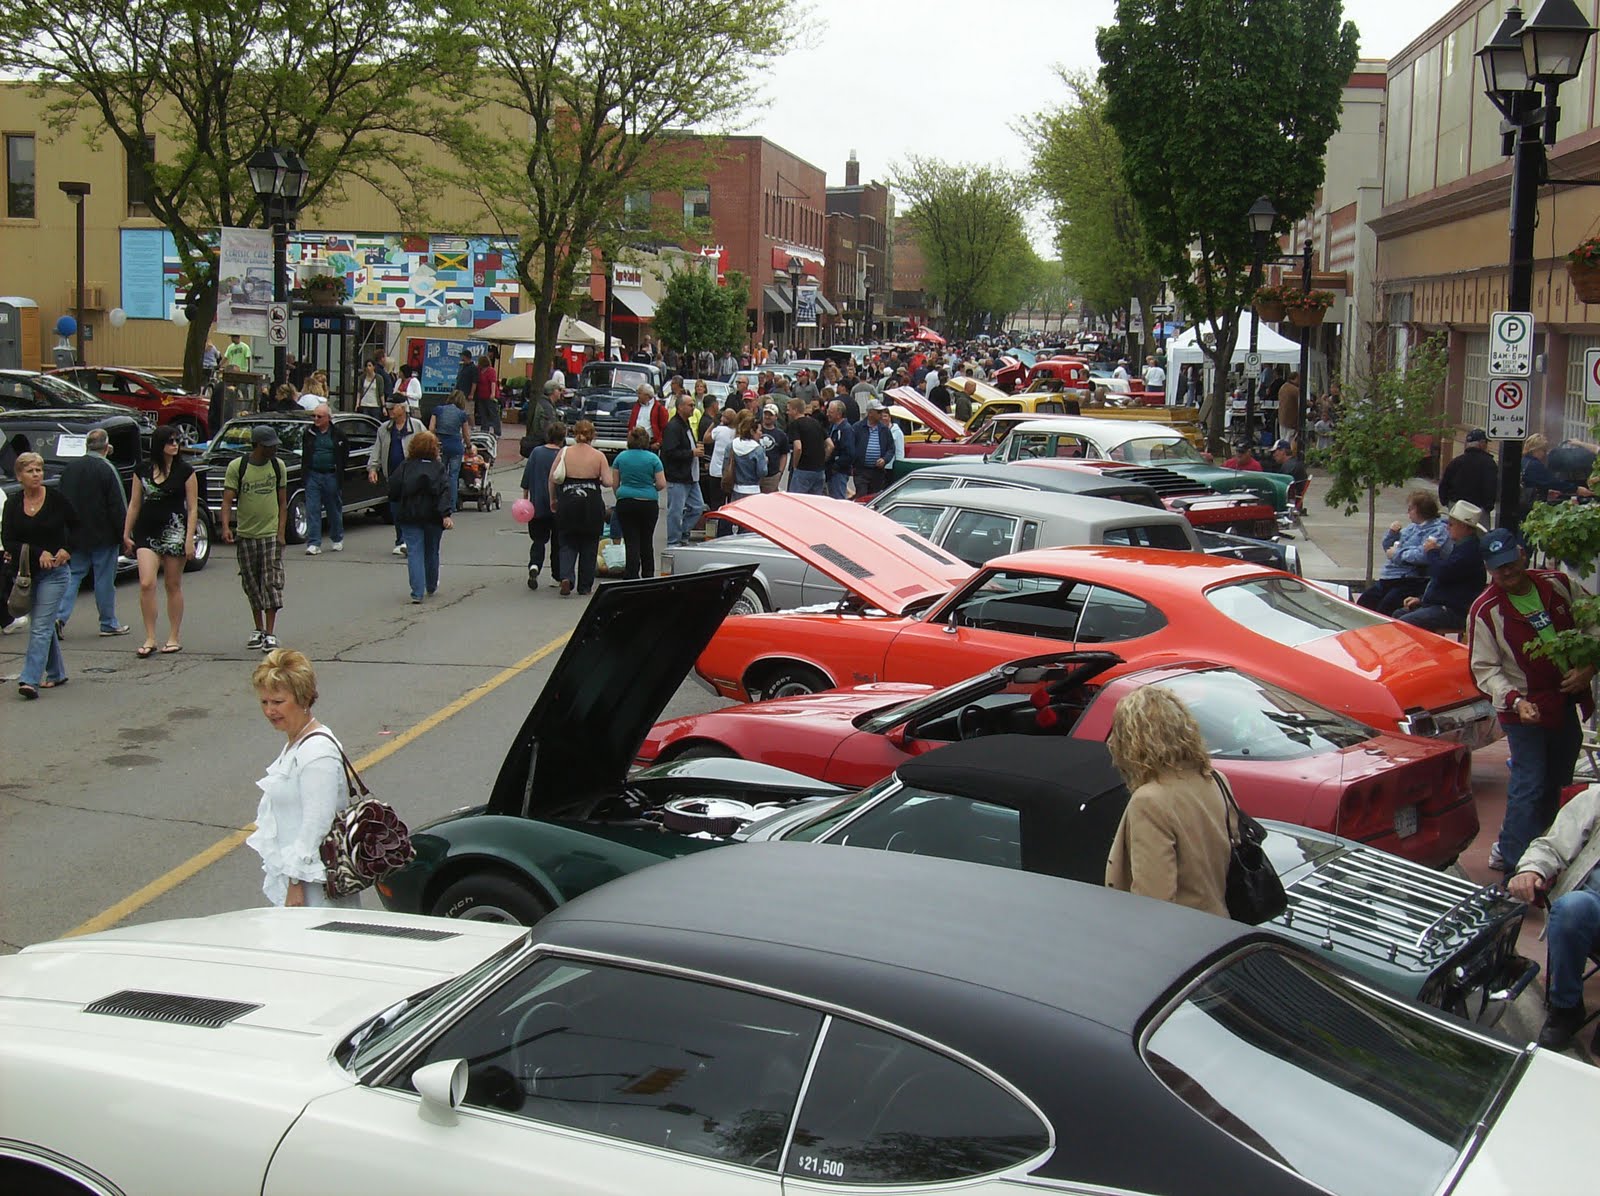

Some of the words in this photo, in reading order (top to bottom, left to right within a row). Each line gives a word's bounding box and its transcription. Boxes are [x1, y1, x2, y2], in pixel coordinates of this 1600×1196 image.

[313, 318, 330, 329] Bell
[1507, 322, 1518, 337] P
[798, 1155, 845, 1177] $21,500
